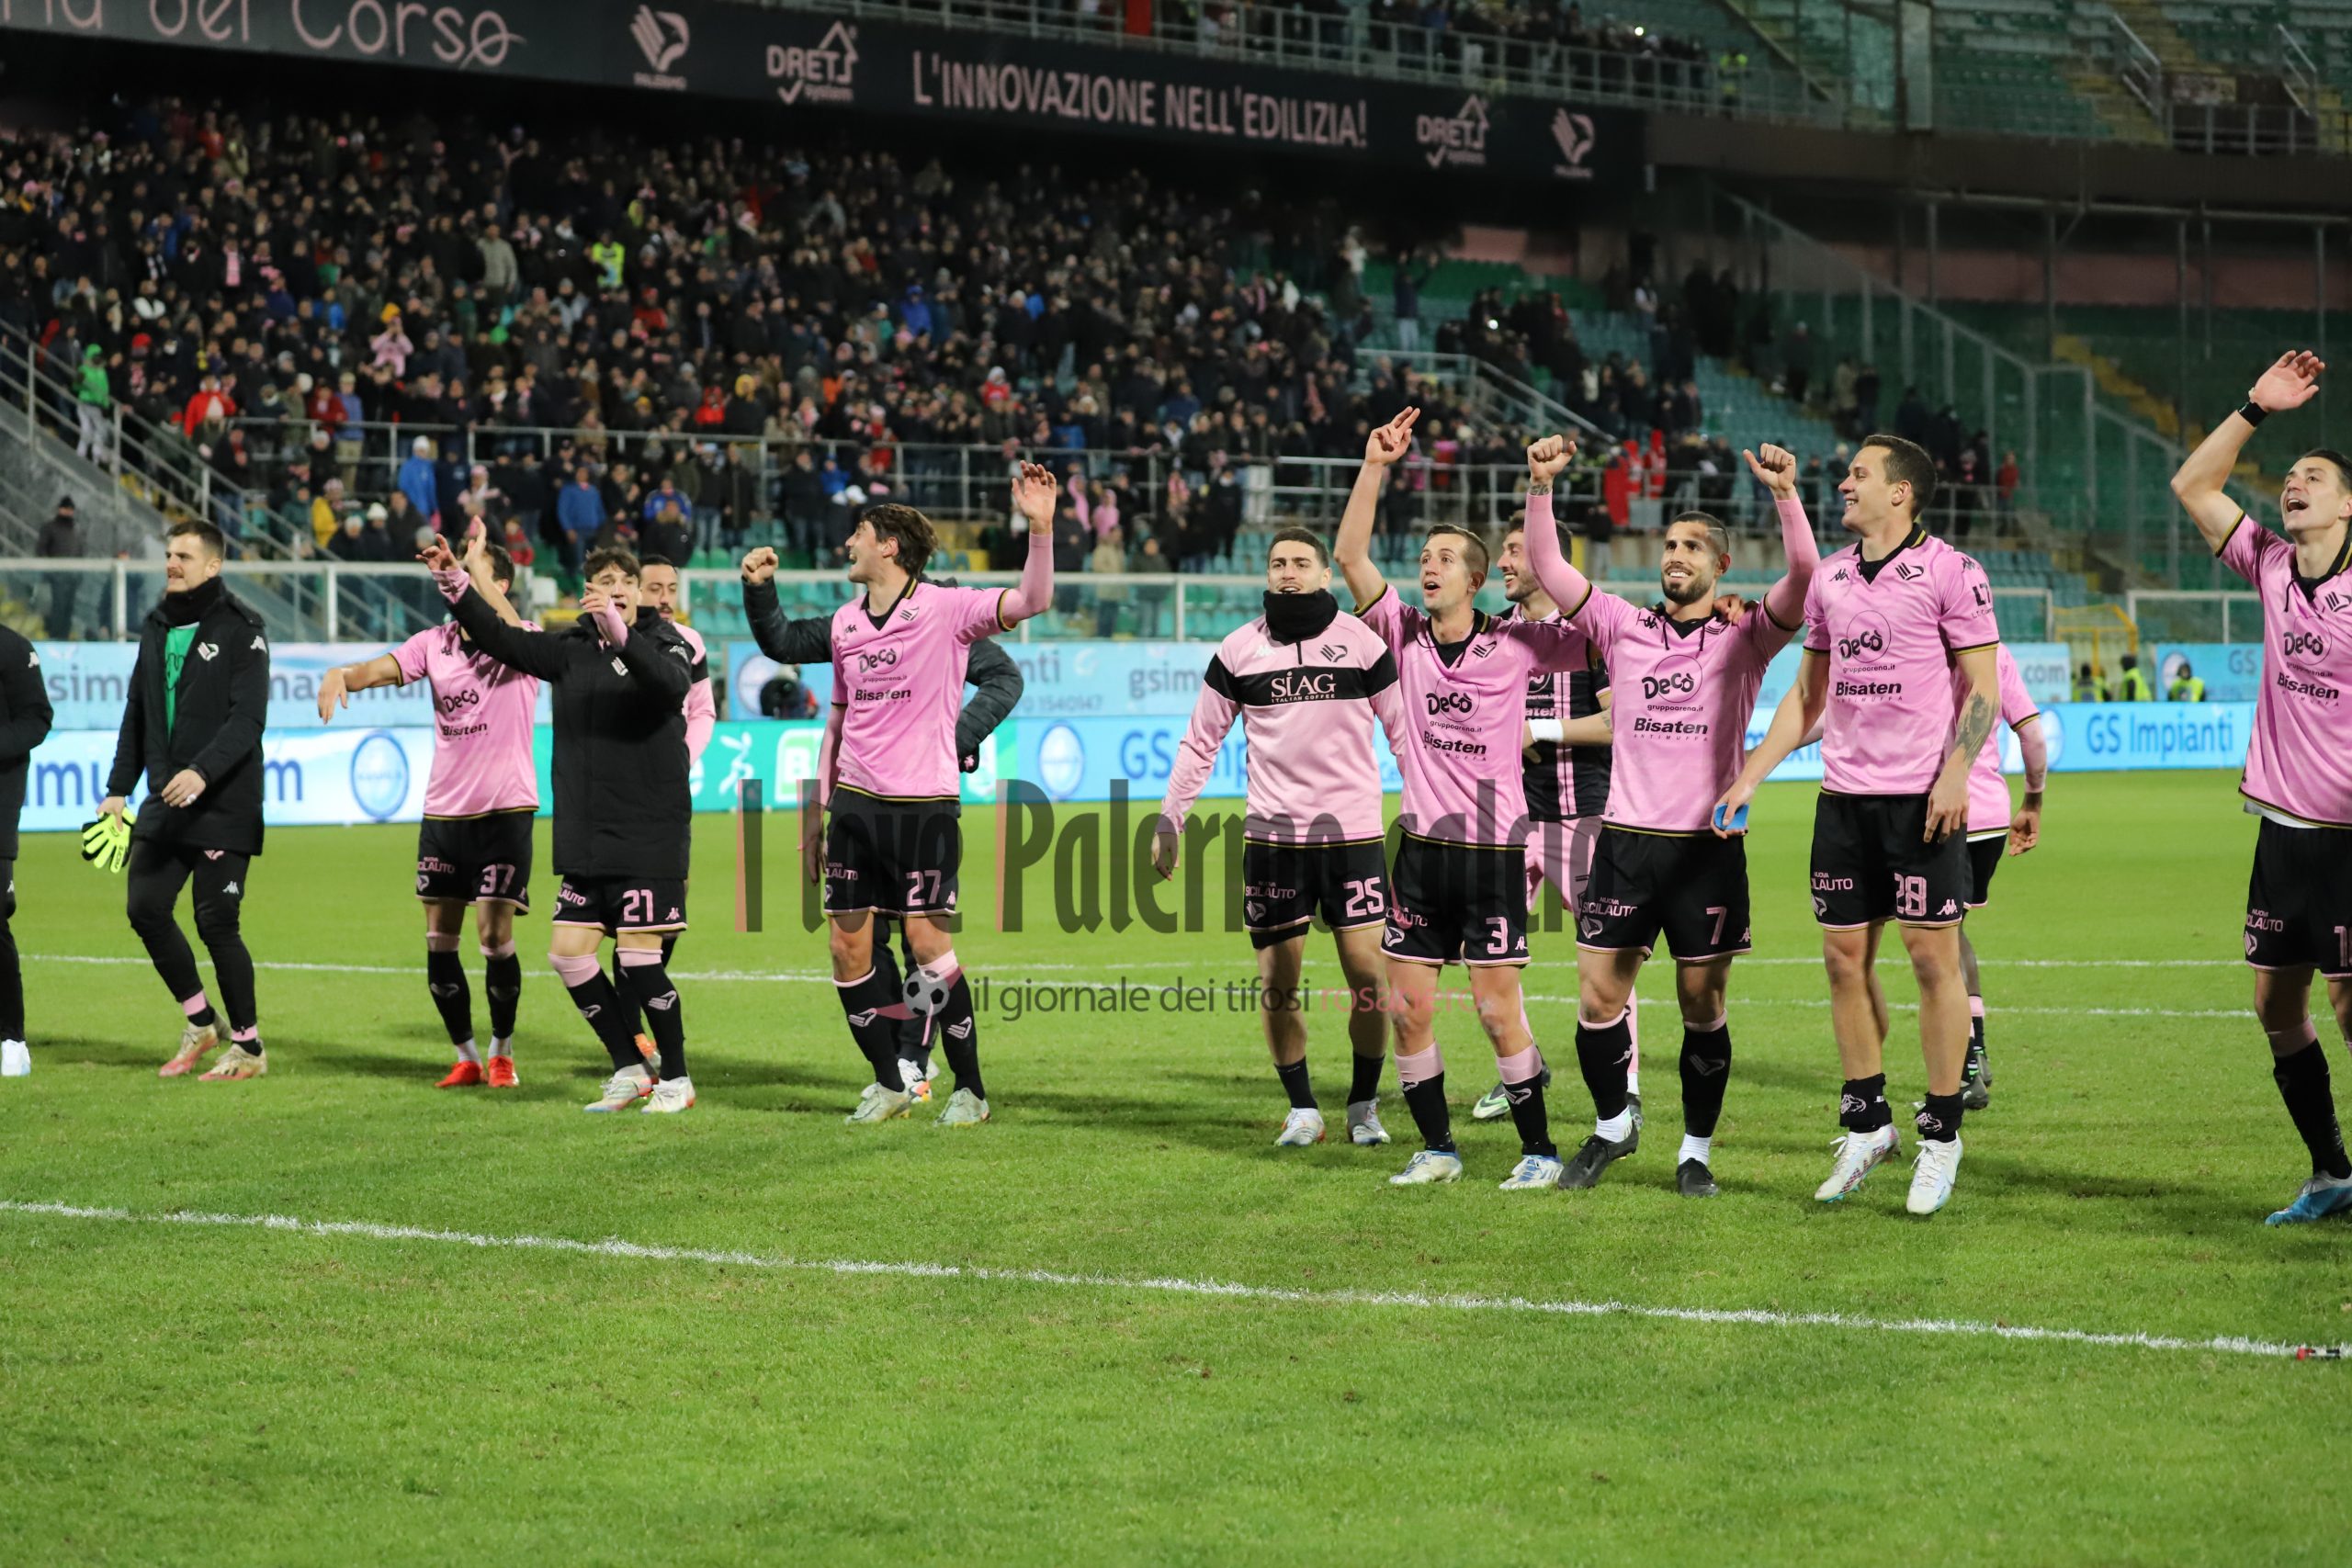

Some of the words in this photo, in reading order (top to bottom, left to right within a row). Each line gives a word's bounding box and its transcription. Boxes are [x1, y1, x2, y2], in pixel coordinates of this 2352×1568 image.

[291, 0, 527, 69] Corso
[912, 50, 1157, 127] L'INNOVAZIONE
[1164, 85, 1368, 148] NELL'EDILIZIA!
[854, 688, 911, 701] Bisaten
[1835, 682, 1903, 697] Bisaten
[2277, 671, 2340, 701] Bisaten
[1423, 729, 1487, 756] Bisaten
[1634, 716, 1710, 735] Bisaten
[2086, 713, 2121, 753] GS
[2130, 713, 2234, 761] Impianti
[480, 863, 515, 895] 37
[906, 869, 942, 907] 27
[1342, 876, 1385, 918] 25
[1894, 872, 1928, 917] 28
[622, 888, 654, 922] 21
[1486, 916, 1509, 954] 3
[1706, 906, 1727, 945] 7
[2334, 925, 2352, 967] 1
